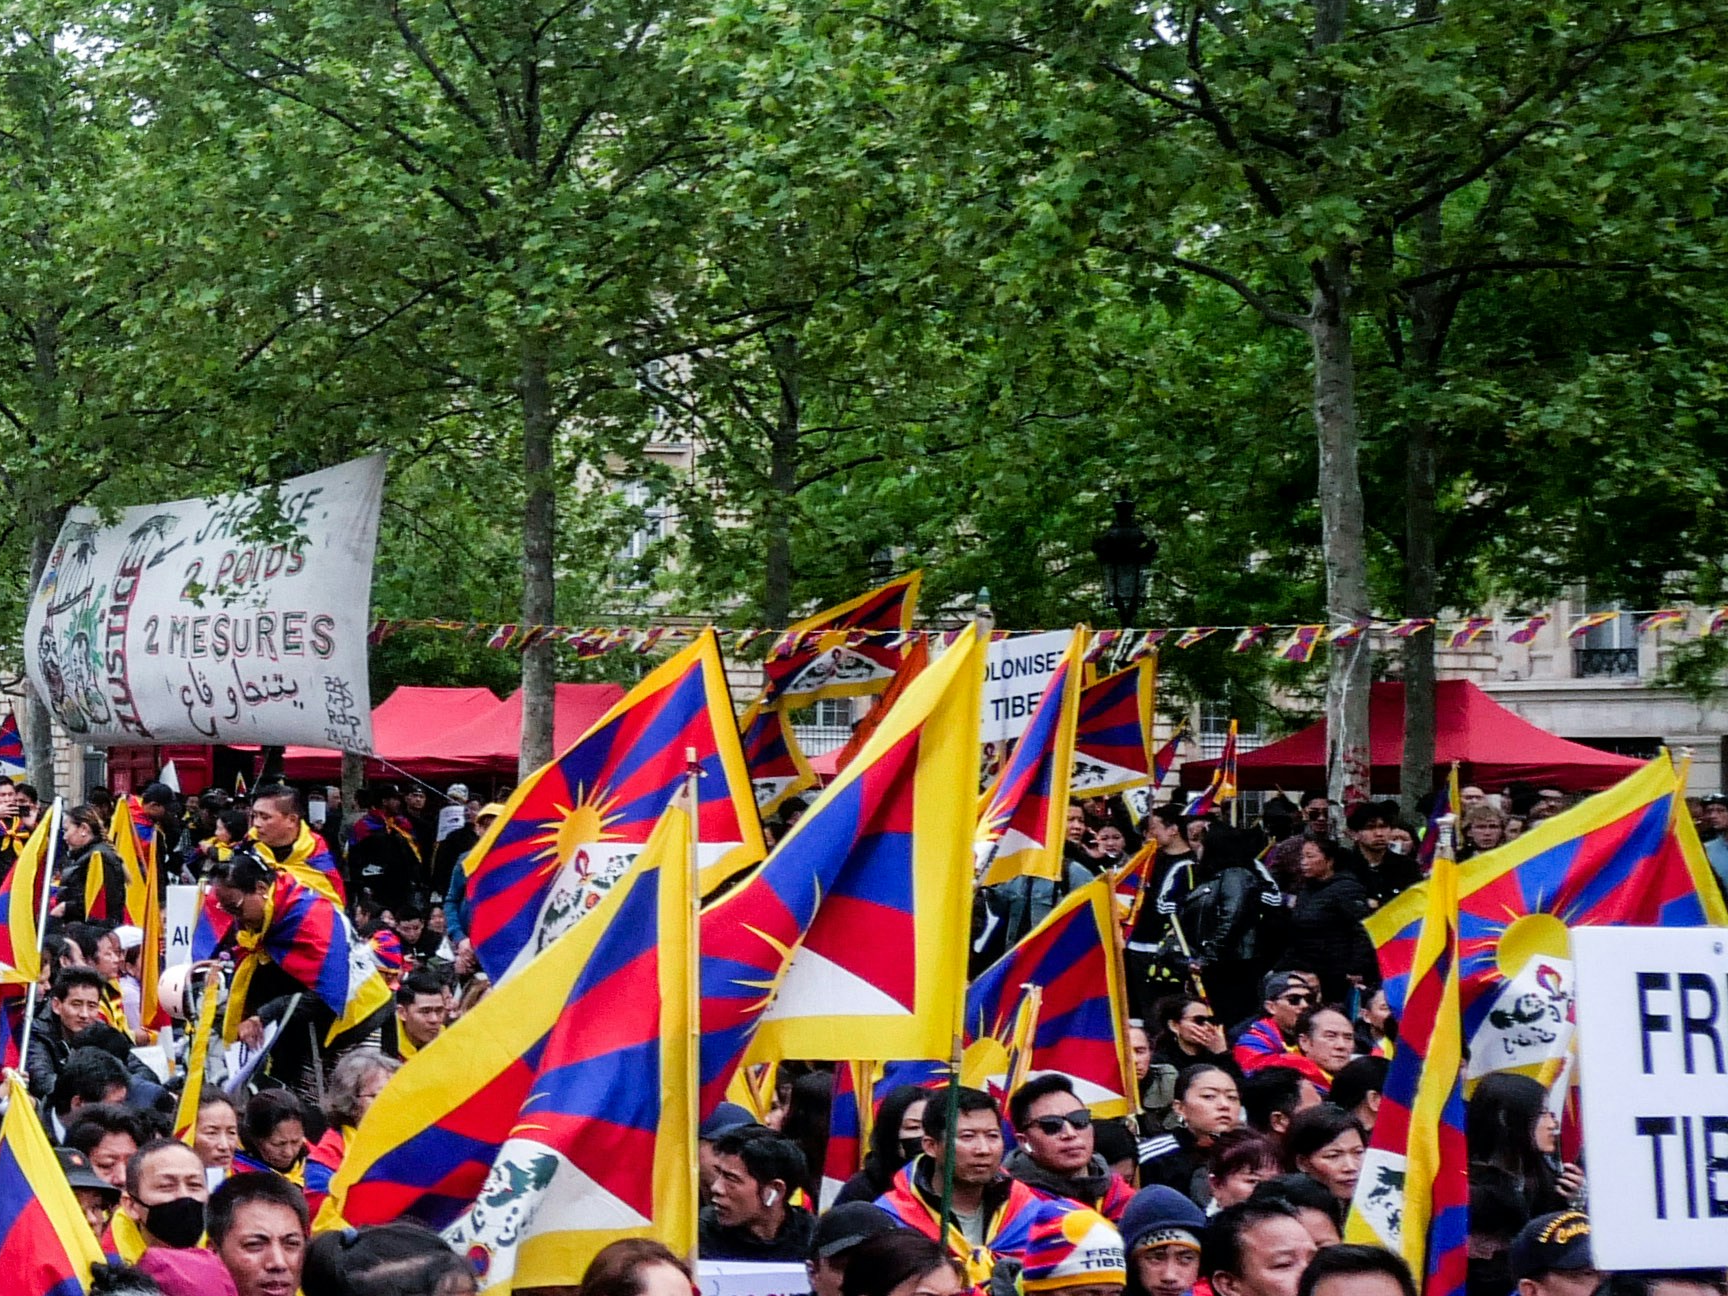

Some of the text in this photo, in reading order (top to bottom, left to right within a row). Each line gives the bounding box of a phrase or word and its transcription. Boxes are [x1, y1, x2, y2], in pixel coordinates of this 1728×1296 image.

[180, 544, 305, 602] 2 POIDS
[144, 611, 335, 660] 2 MESURES
[984, 651, 1064, 682] LONISE
[991, 691, 1045, 721] TIBE
[1635, 972, 1728, 1075] FR
[1080, 1256, 1126, 1269] TIBE
